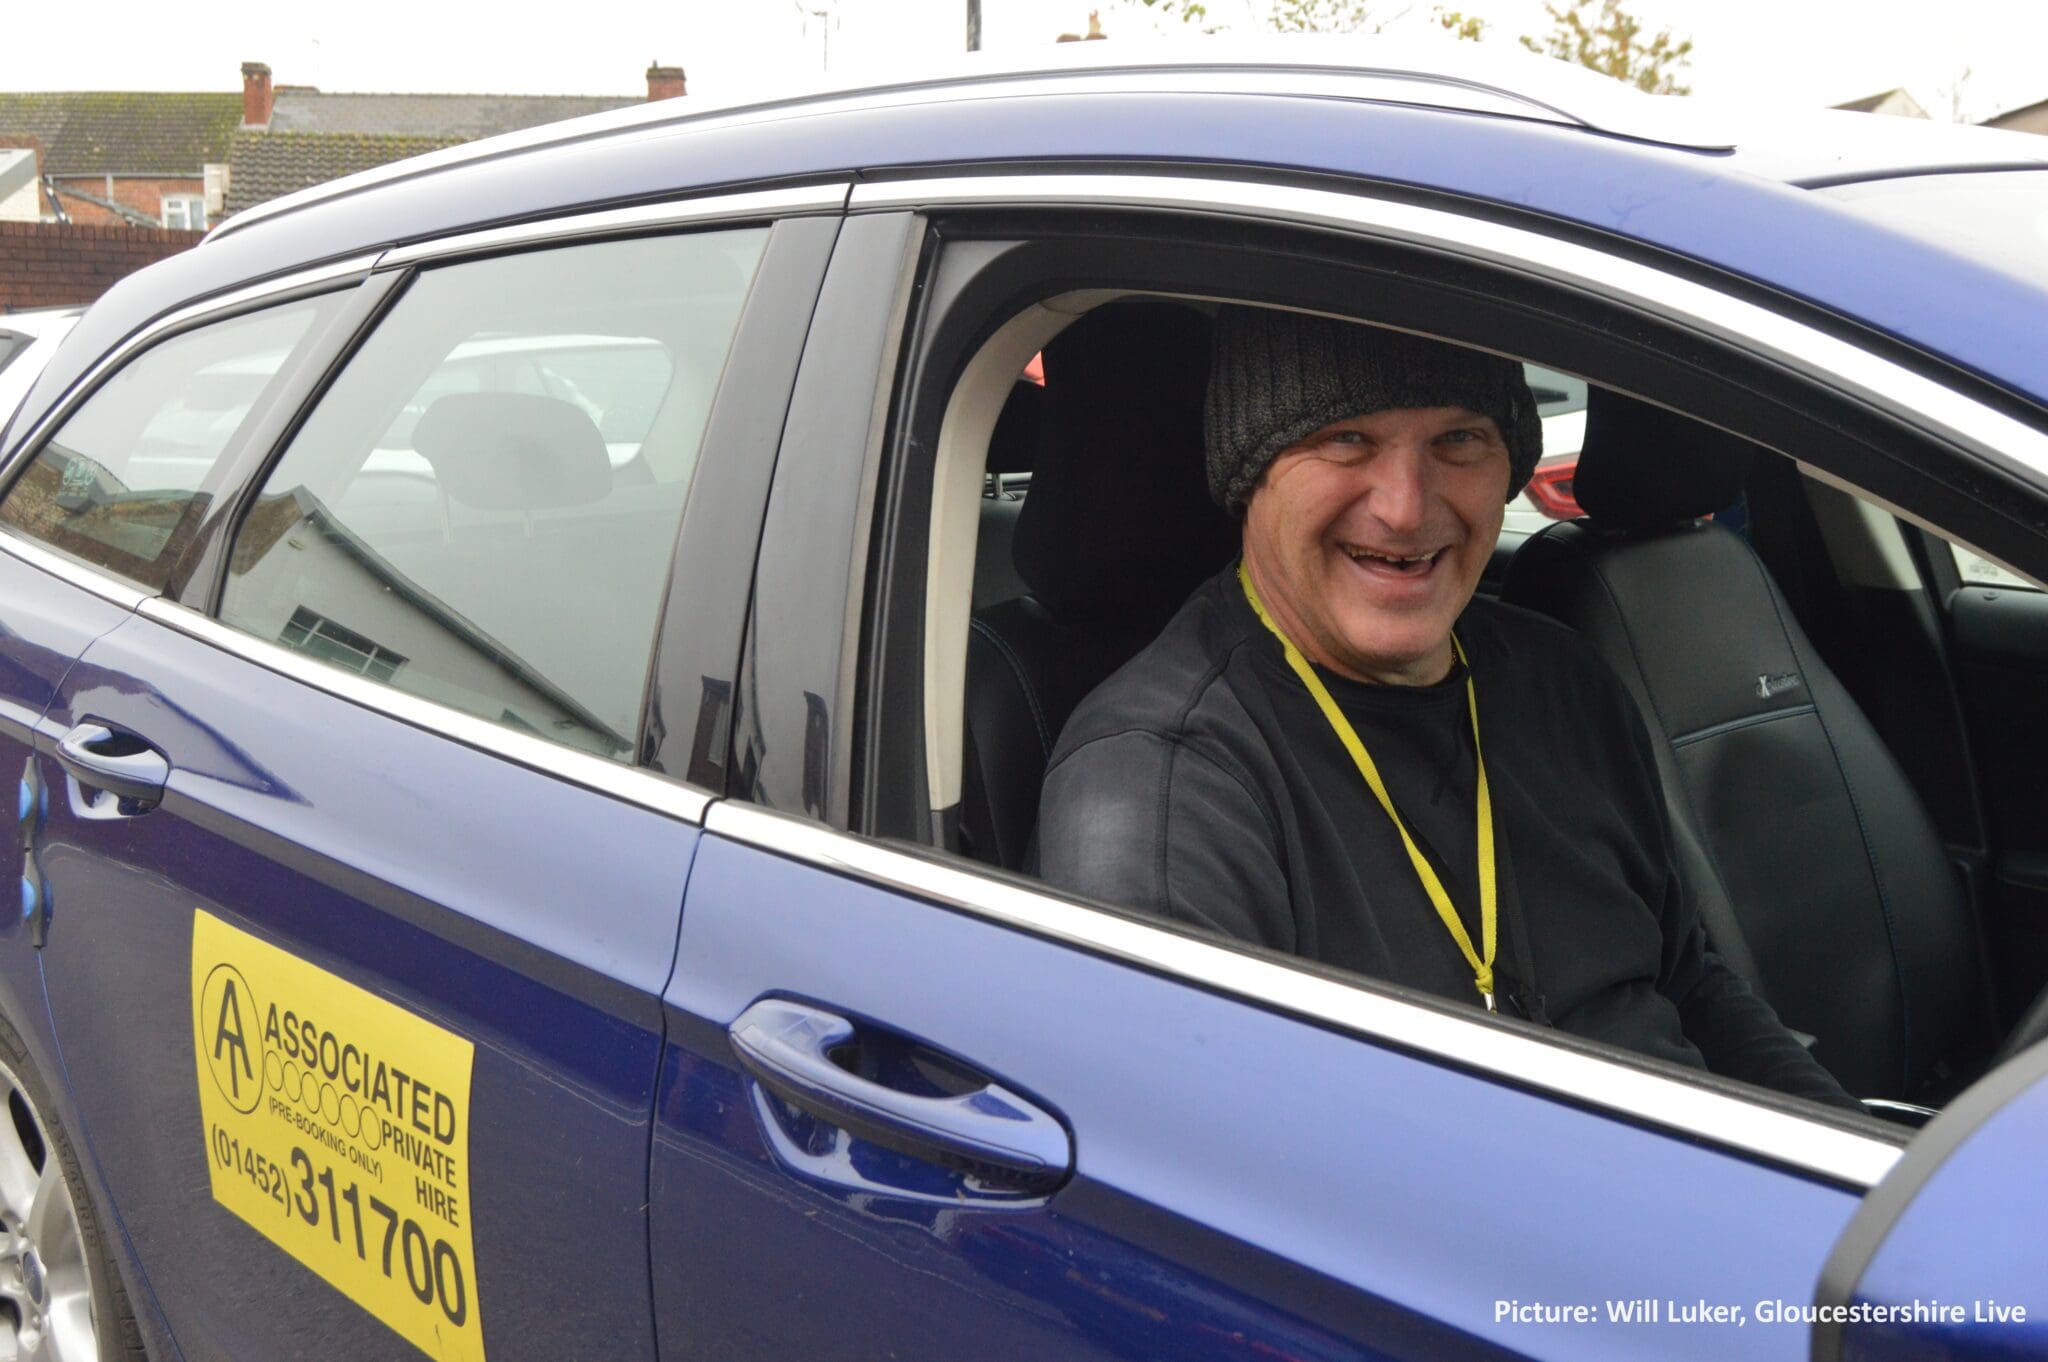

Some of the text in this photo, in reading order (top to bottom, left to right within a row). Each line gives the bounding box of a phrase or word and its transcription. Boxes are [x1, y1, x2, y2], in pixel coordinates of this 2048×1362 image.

[265, 1002, 456, 1146] ASSOCIATED
[269, 1095, 384, 1184] (PRE-BOOKING ONLY)
[382, 1119, 457, 1189] PRIVATE
[212, 1123, 467, 1328] (01452) 311700
[415, 1176, 460, 1228] HIRE
